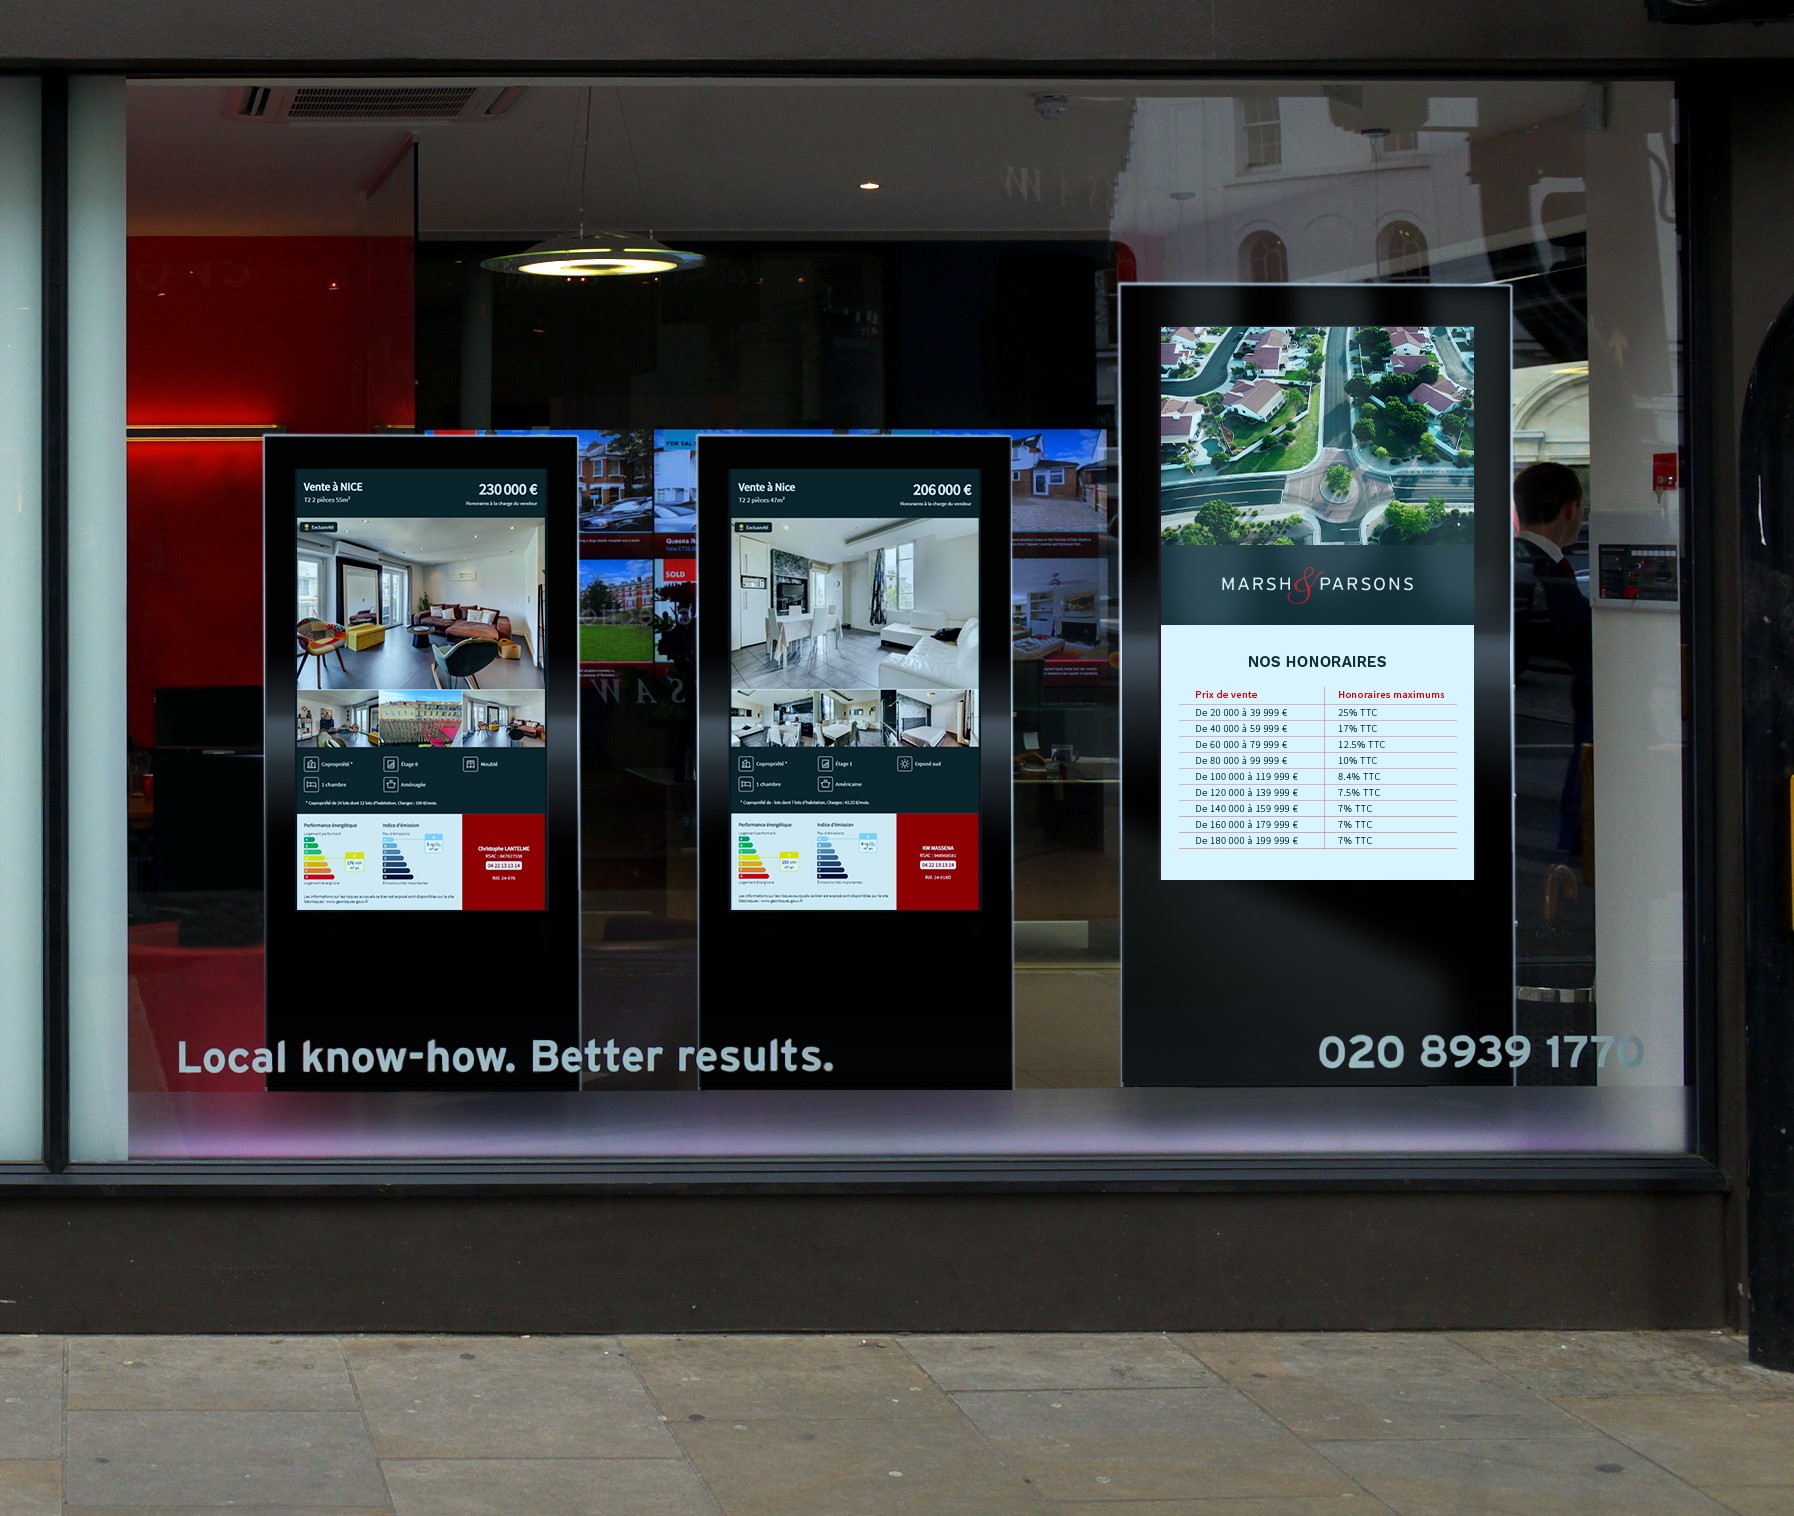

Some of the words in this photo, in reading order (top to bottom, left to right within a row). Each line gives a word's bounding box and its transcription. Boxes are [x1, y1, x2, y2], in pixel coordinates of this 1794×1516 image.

[304, 483, 330, 491] Vente
[333, 481, 338, 491] à
[341, 482, 363, 491] NICE
[479, 484, 502, 495] 230
[504, 484, 526, 495] 000
[529, 484, 538, 495] €
[738, 483, 765, 491] Vente
[767, 482, 773, 491] à
[775, 483, 795, 491] Nice
[913, 484, 936, 495] 206
[938, 484, 961, 495] 000
[964, 484, 972, 495] €
[1249, 656, 1280, 667] NOS
[1287, 656, 1386, 667] HONORAIRES
[1196, 690, 1214, 698] Prix
[1217, 690, 1228, 698] de
[1242, 708, 1246, 716] à
[1242, 724, 1246, 732] à
[1242, 740, 1246, 748] à
[1242, 756, 1246, 764] à
[1248, 772, 1252, 780] à
[1248, 788, 1252, 796] à
[1248, 804, 1252, 812] à
[1248, 820, 1252, 828] à
[1248, 836, 1252, 844] à
[1319, 1034, 1404, 1069] 020
[1420, 1034, 1531, 1069] 8939
[1546, 1035, 1644, 1069] 1770
[179, 1040, 285, 1073] Local
[303, 1039, 515, 1073] know-how.
[532, 1039, 664, 1073] Better
[678, 1039, 833, 1073] results.
